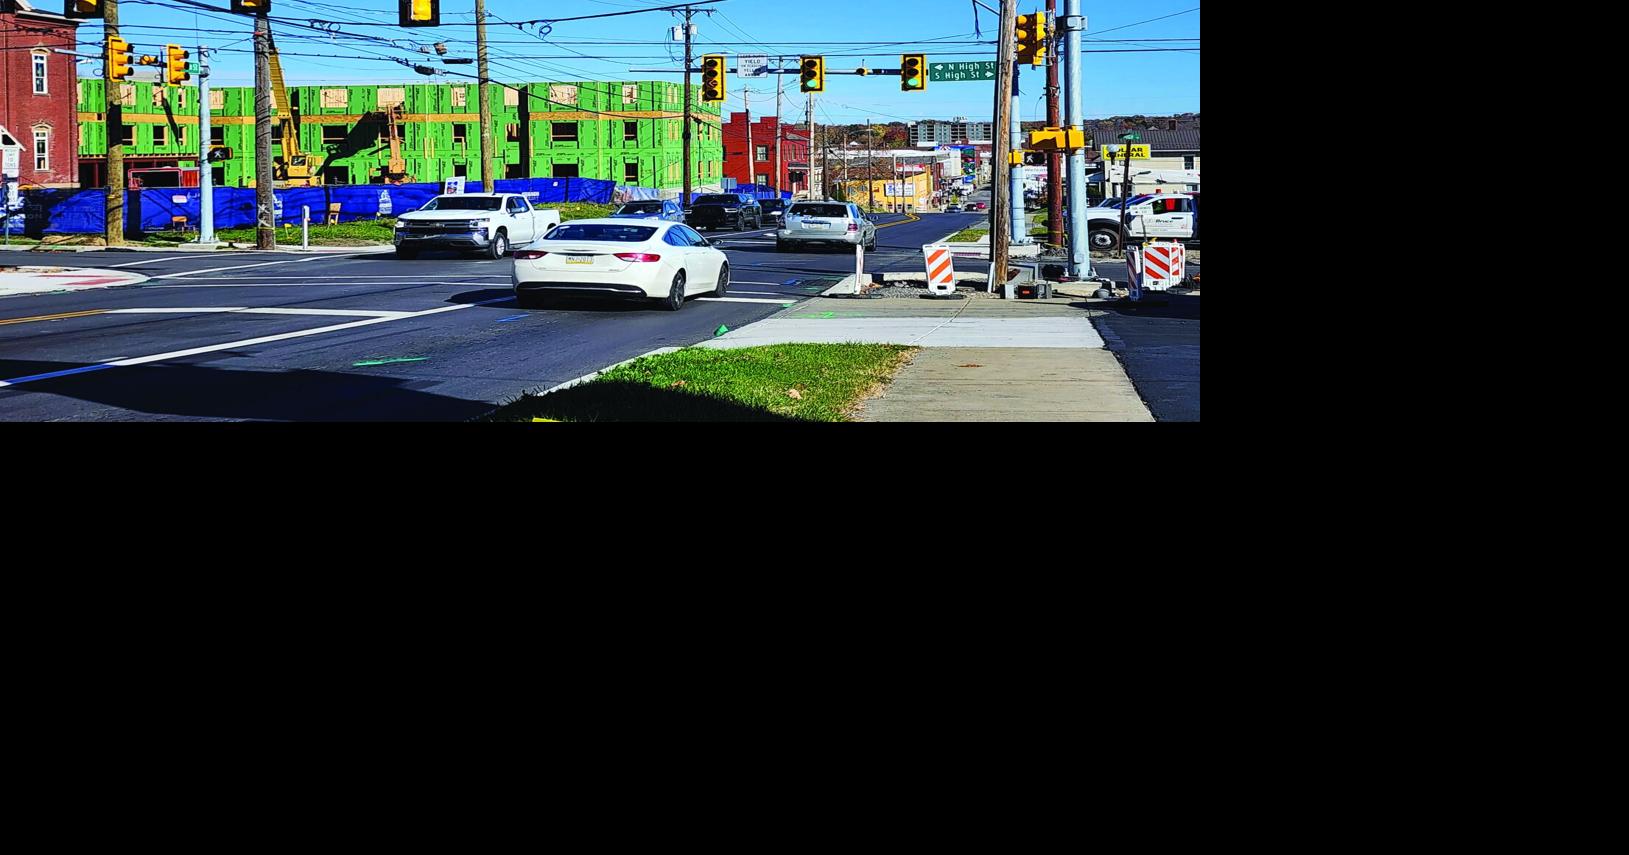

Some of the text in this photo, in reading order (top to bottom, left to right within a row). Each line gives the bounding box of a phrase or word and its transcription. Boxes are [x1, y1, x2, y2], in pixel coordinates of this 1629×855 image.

[959, 62, 980, 71] High
[985, 62, 994, 70] St
[935, 71, 980, 81] S High St
